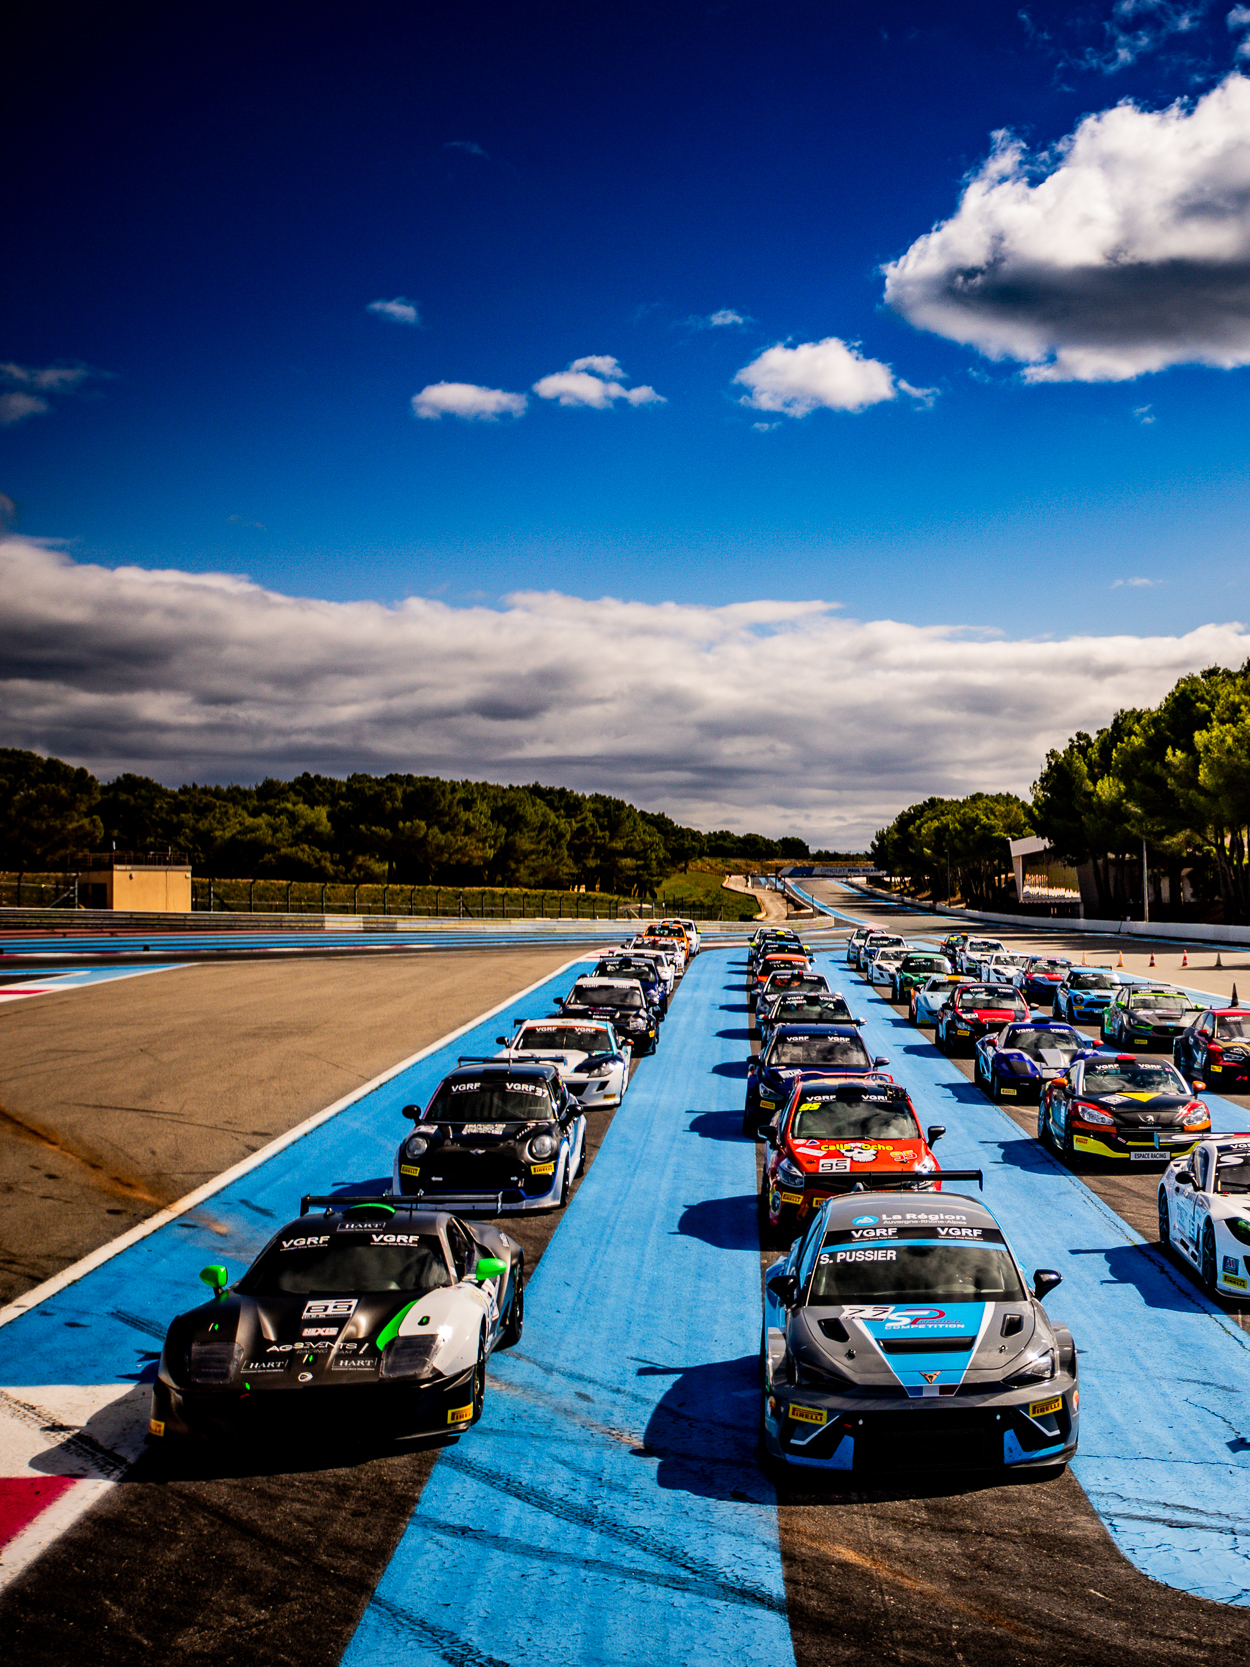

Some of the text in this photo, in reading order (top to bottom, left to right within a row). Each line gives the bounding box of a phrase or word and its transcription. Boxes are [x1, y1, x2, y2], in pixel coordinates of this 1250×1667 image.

[451, 1083, 481, 1092] VGRF
[506, 1083, 535, 1092] VGRF
[535, 1087, 549, 1098] 37
[799, 1102, 822, 1111] 95
[890, 1150, 917, 1161] 95
[1134, 1152, 1167, 1160] ESPACE RACING
[821, 1160, 848, 1171] 95
[882, 1212, 967, 1222] La Région
[851, 1227, 898, 1239] VGRF
[937, 1227, 983, 1237] VGRF
[282, 1235, 330, 1248] VGRF
[371, 1234, 420, 1244] VGRF
[819, 1250, 897, 1265] S. PUSSIER
[848, 1308, 889, 1318] 77
[250, 1361, 285, 1369] HART
[339, 1359, 374, 1367] HART
[1031, 1398, 1060, 1415] PIRELLI
[792, 1406, 824, 1422] PIRELLI
